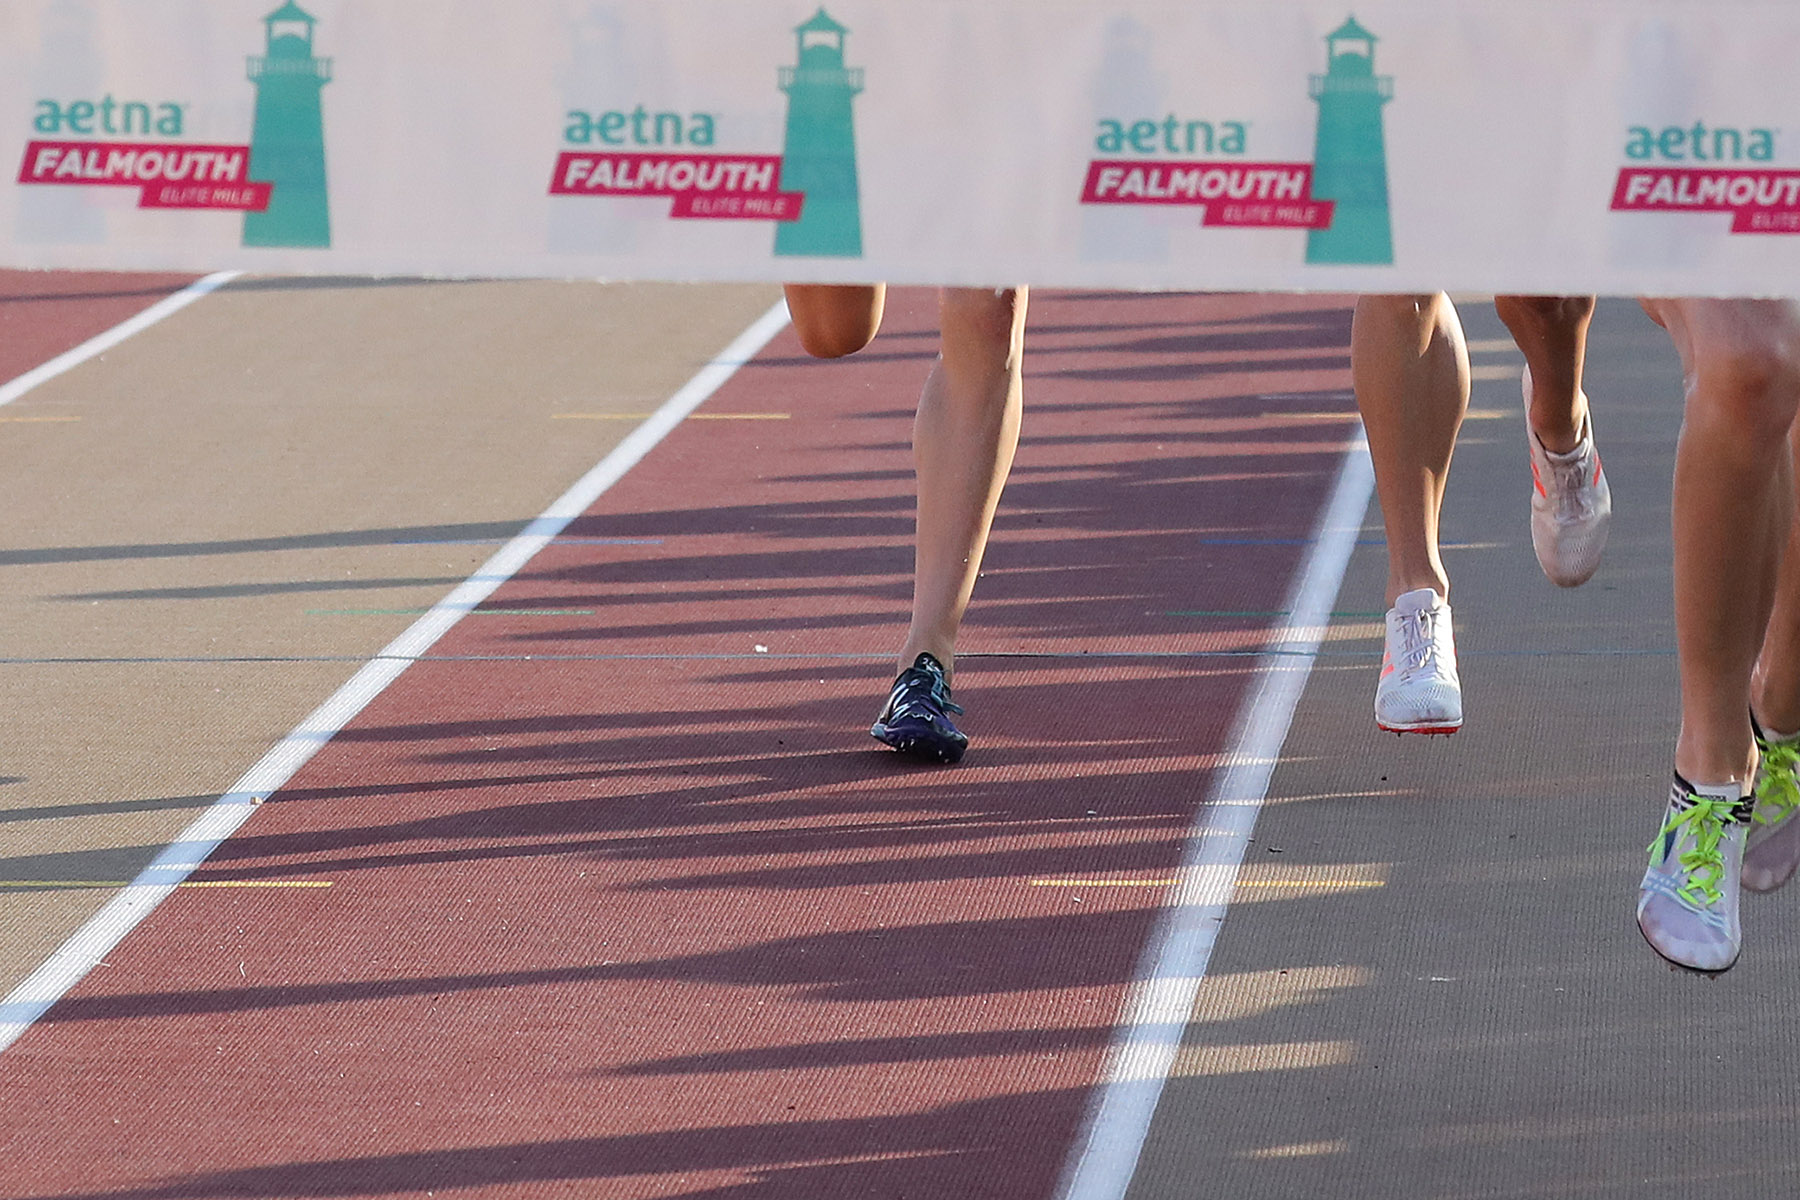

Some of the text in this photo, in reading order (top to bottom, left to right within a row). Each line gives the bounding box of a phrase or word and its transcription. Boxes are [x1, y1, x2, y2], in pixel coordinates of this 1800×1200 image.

[33, 93, 184, 136] aetna
[565, 104, 715, 146] aetna
[1096, 113, 1247, 154] aetna
[1625, 120, 1775, 161] aetna
[32, 148, 242, 181] FALMOUTH
[563, 159, 774, 191] FALMOUTH
[212, 187, 254, 204] MILE
[1094, 167, 1305, 199] FALMOUTH
[743, 198, 786, 215] MILE
[1275, 206, 1318, 223] MILE
